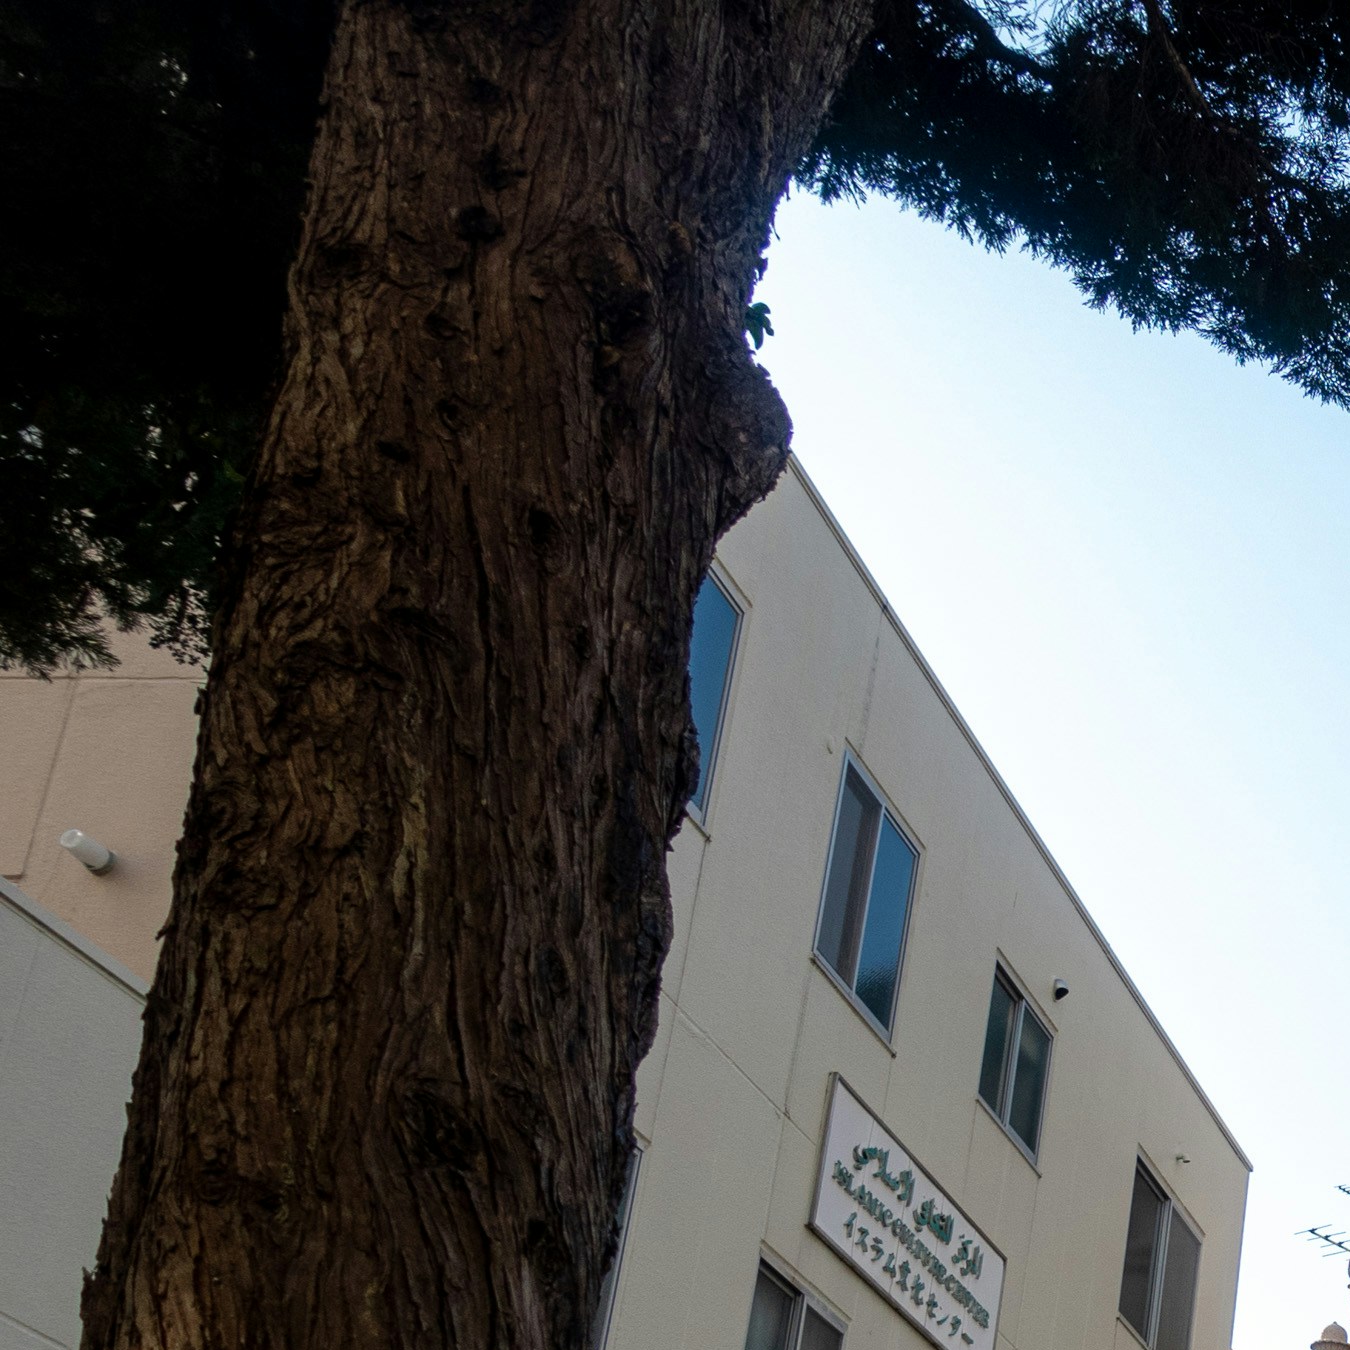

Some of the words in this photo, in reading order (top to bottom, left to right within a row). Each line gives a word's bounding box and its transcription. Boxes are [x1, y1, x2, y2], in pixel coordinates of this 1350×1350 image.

[832, 1159, 893, 1228] ISLAMIC
[943, 1273, 990, 1330] CENTER
[843, 1211, 975, 1346] イスラム文化センター
